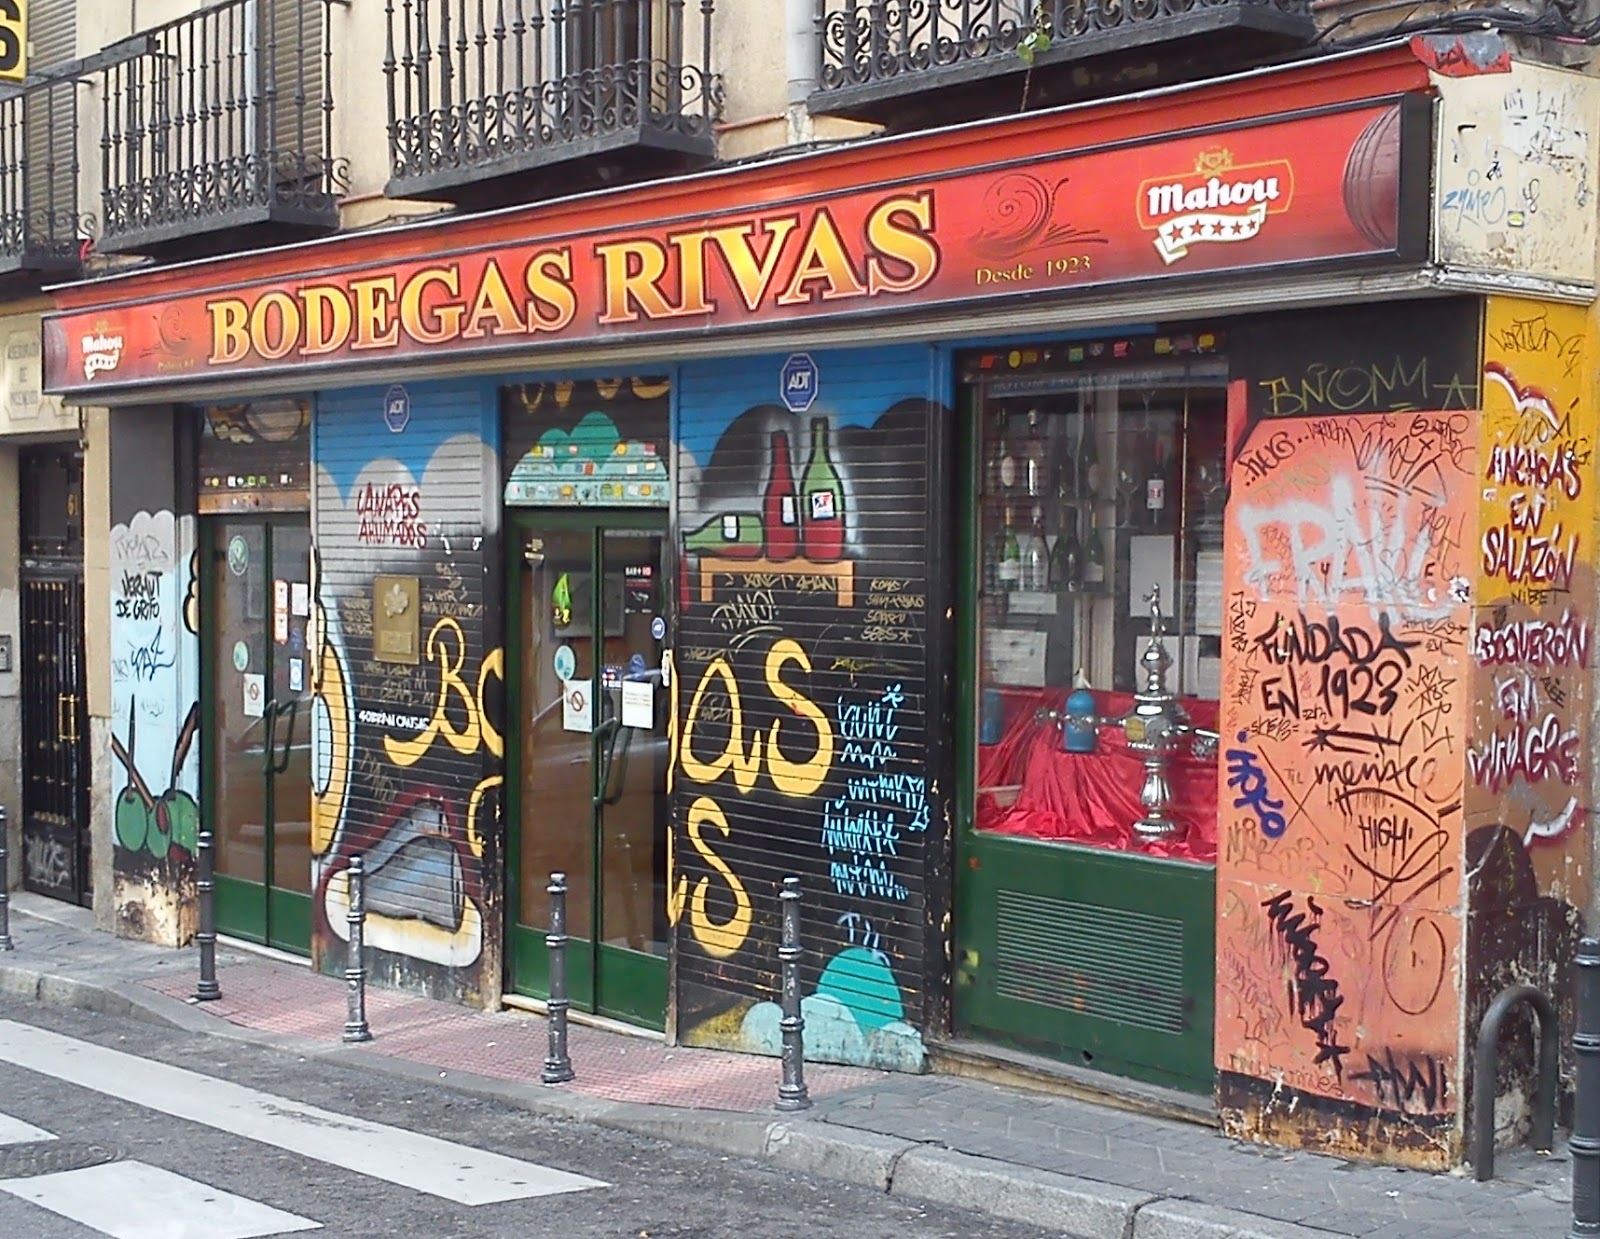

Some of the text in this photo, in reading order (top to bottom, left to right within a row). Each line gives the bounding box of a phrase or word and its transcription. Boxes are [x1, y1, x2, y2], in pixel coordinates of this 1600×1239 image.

[1147, 177, 1280, 216] Mahou
[207, 190, 939, 366] BODEGAS RIVAS
[976, 255, 1092, 285] Desde 1923
[787, 371, 811, 390] ADT
[389, 400, 405, 414] ADT
[1510, 493, 1546, 535] EN
[358, 518, 427, 550] AHUMADOS
[115, 599, 131, 618] DE
[1254, 611, 1421, 668] FUNDADA
[1261, 664, 1300, 719] EN
[1318, 661, 1403, 719] 1923
